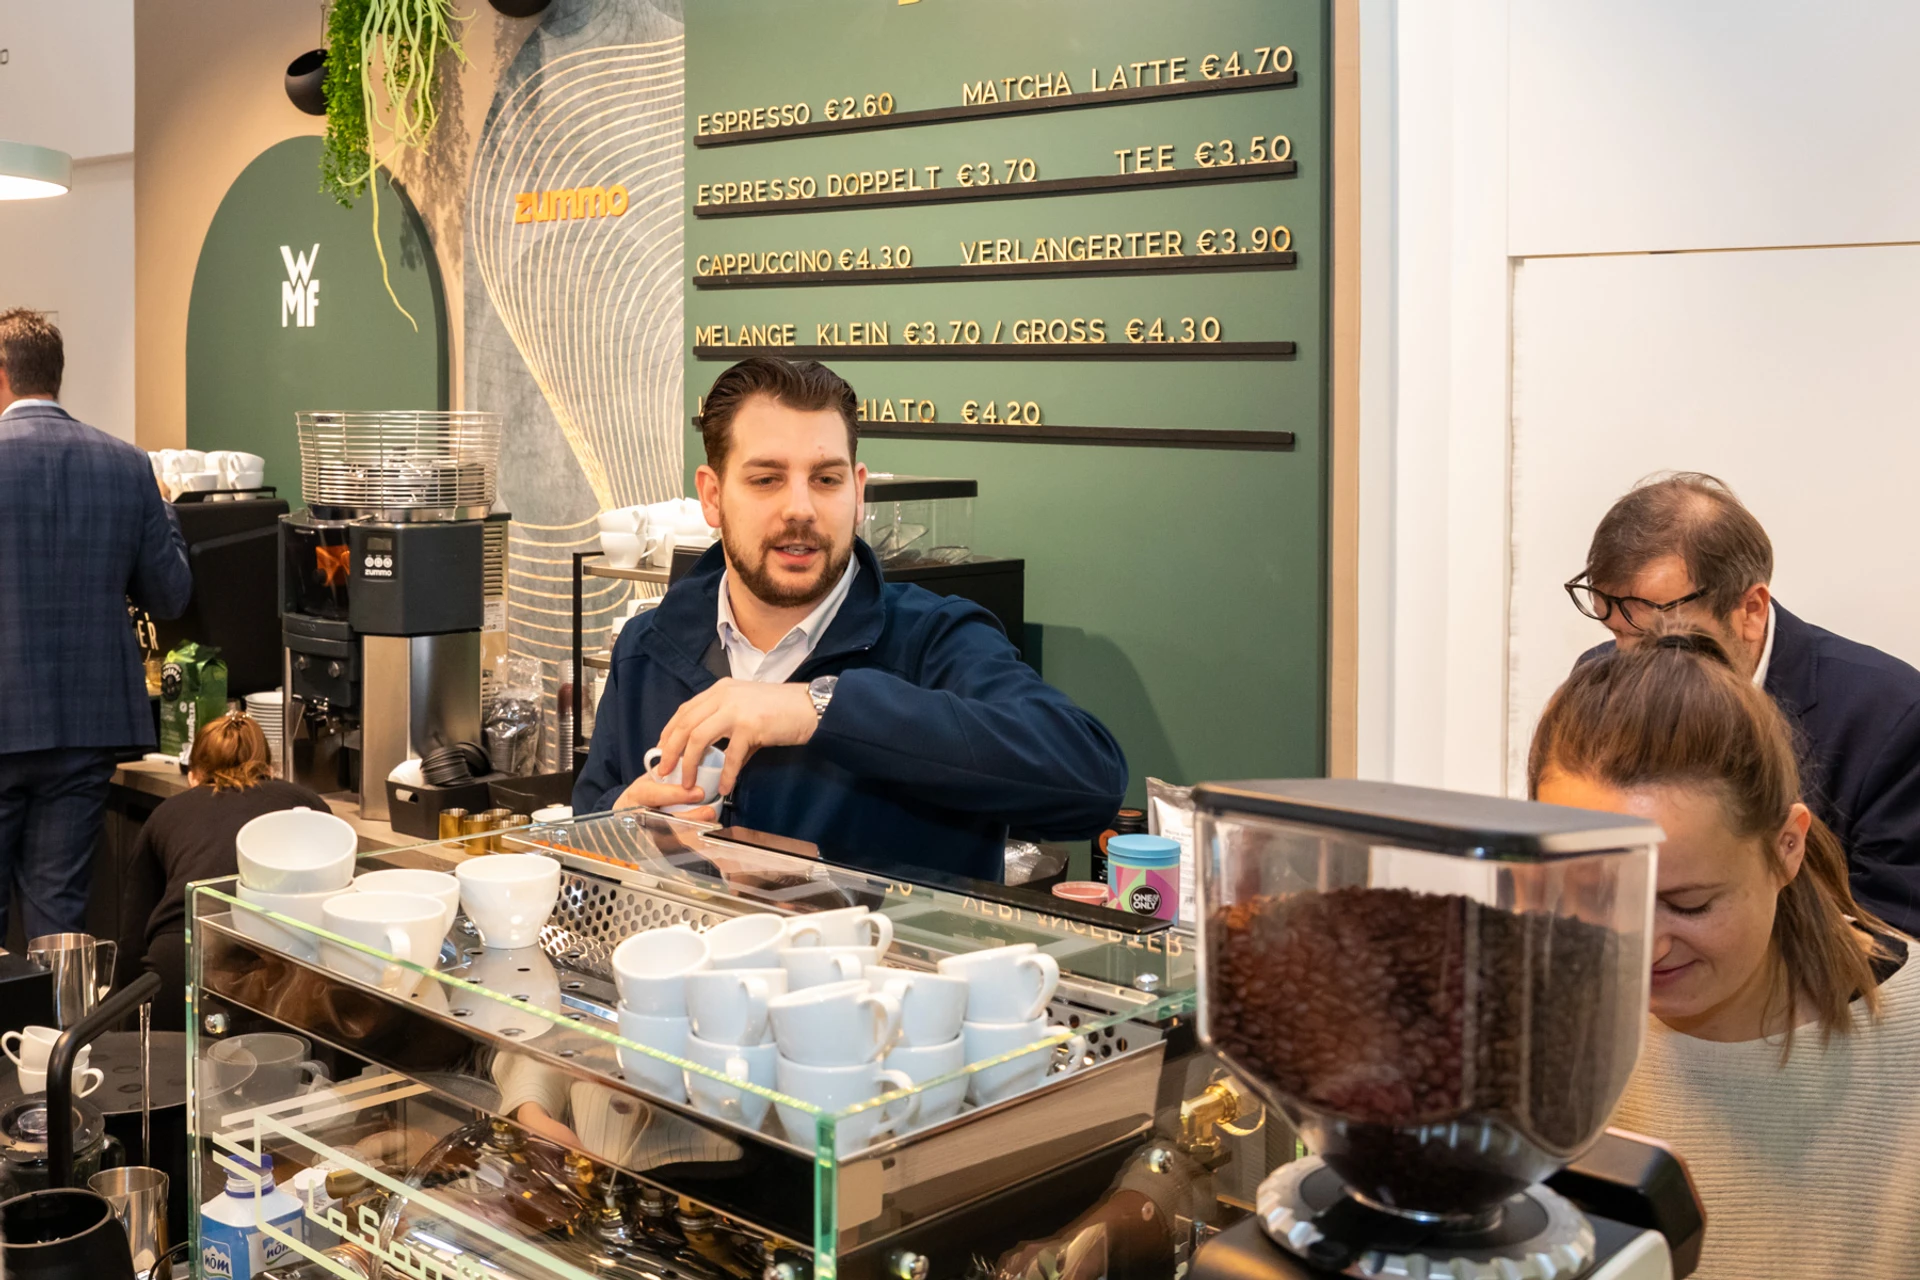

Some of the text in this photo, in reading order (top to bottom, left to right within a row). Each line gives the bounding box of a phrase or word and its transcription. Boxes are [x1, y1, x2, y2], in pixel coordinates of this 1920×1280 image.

[962, 45, 1294, 106] MATCHA LATTE €4.70
[697, 92, 894, 136] ESPRESSO €2.60
[1114, 135, 1293, 175] TEE €3.50
[697, 157, 1038, 206] ESPRESSO DOPPELT €3.70
[514, 184, 630, 223] zummo
[1196, 225, 1293, 256] €3.90
[696, 245, 913, 277] CAPPUCCINO €4.30
[280, 243, 320, 328] WMF
[695, 324, 796, 347] MELANGE
[816, 321, 889, 346] KLEIN
[903, 320, 982, 346] €3.70
[1012, 318, 1107, 345] GROSS
[1124, 316, 1222, 343] €4.30
[857, 398, 1042, 426] HIATO €4.20
[364, 568, 393, 577] zummo
[1133, 901, 1157, 910] ONLY
